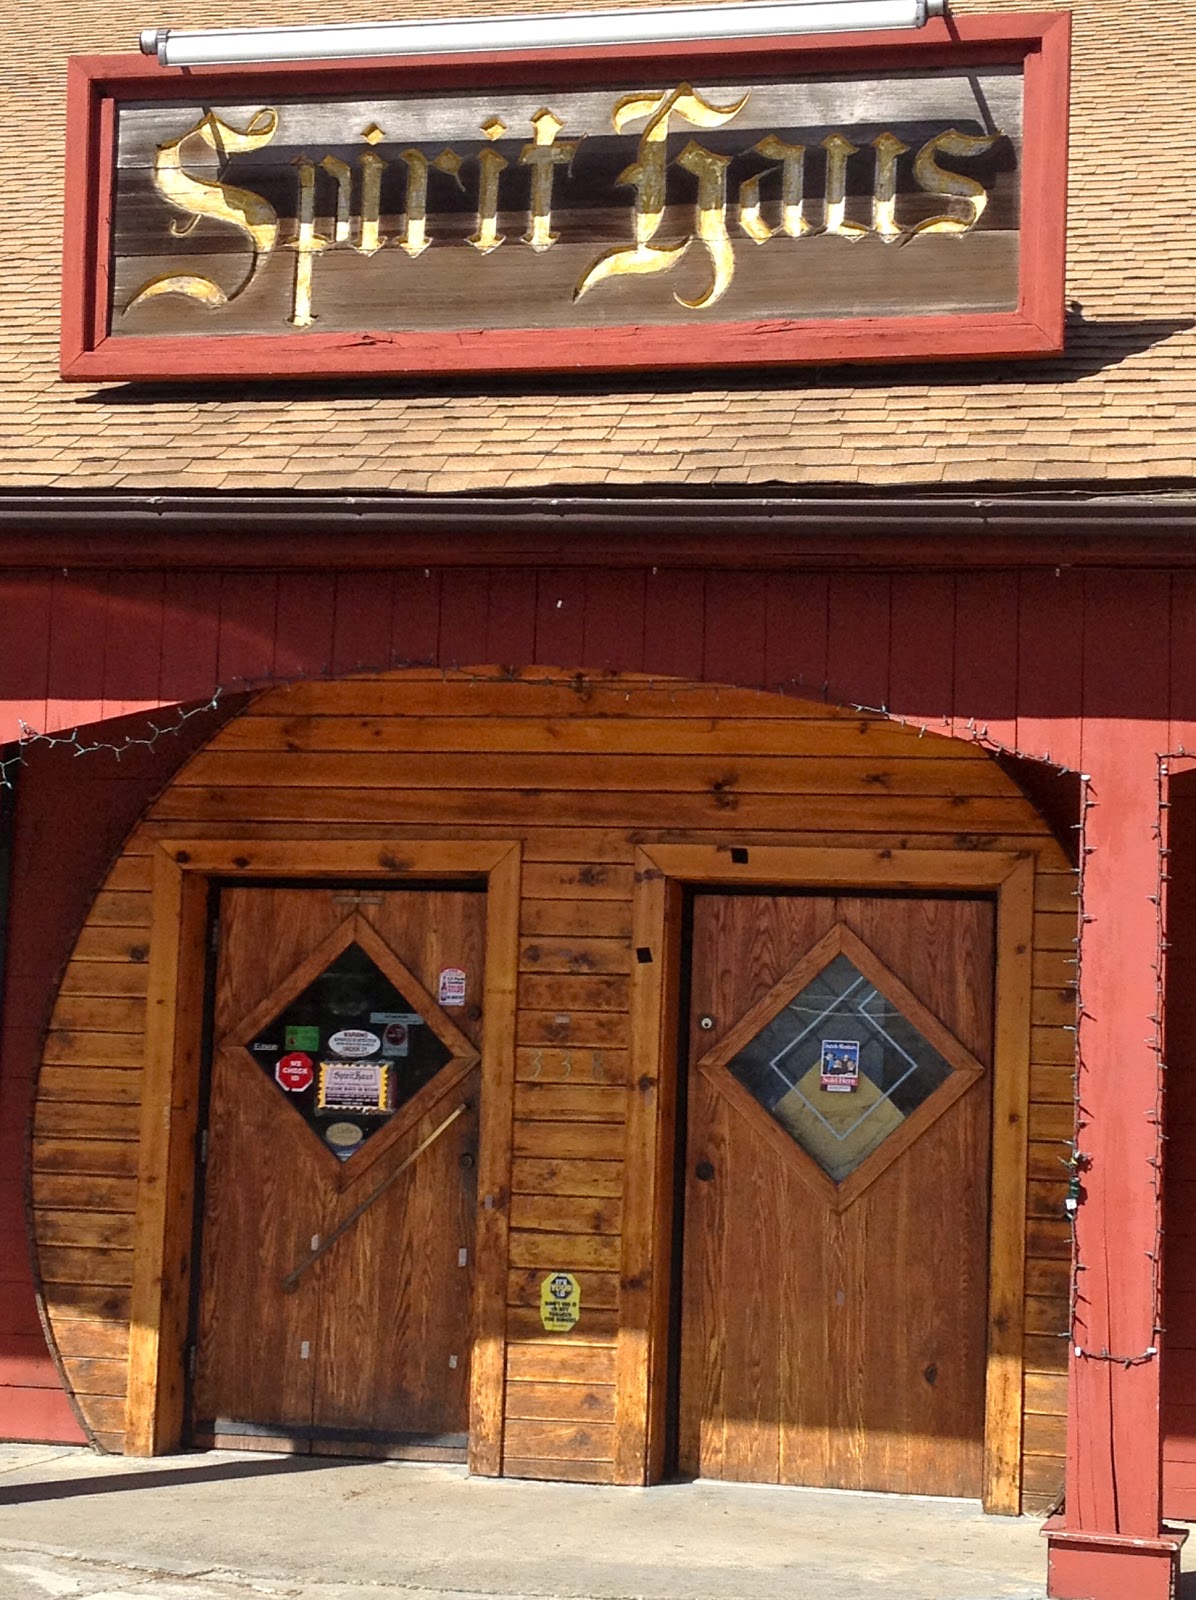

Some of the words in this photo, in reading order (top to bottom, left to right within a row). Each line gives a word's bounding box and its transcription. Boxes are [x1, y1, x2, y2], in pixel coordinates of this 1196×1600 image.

[122, 107, 588, 328] Spirit
[573, 82, 1004, 311] Haus
[282, 1067, 308, 1075] CHECK
